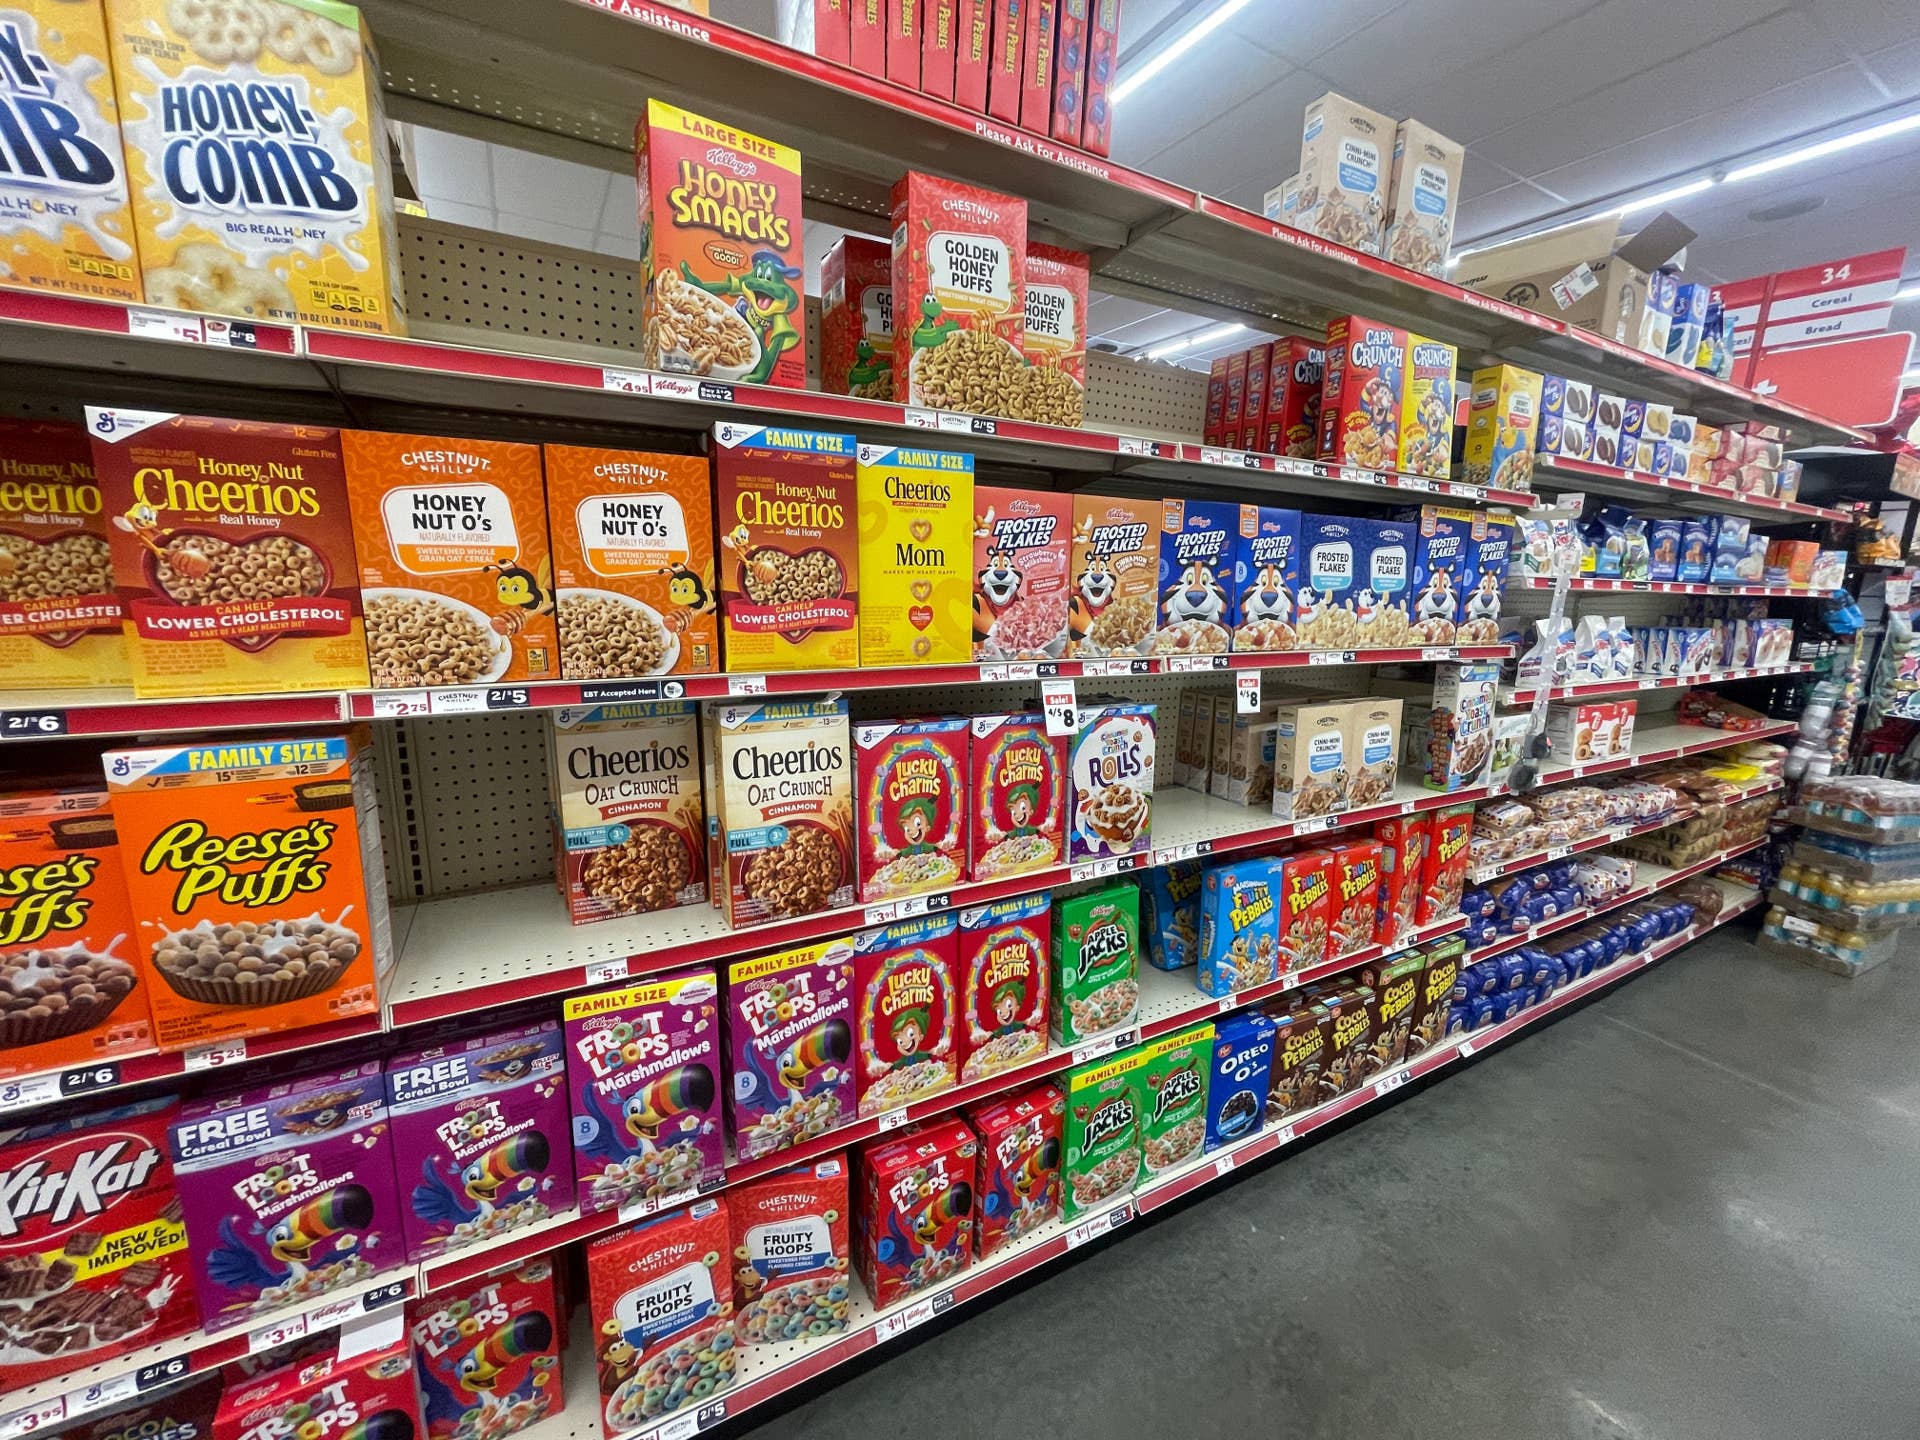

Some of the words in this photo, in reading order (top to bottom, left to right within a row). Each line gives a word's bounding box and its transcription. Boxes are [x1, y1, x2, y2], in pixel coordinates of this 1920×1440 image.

[682, 116, 737, 146] LARGE
[742, 132, 776, 159] SIZE
[975, 122, 1012, 146] Please
[1015, 136, 1035, 154] Ask
[1037, 143, 1055, 160] For
[1057, 151, 1109, 179] Assistance
[669, 187, 791, 249] SMACKS
[942, 199, 1000, 224] CHESTNUT
[226, 222, 247, 234] BIG
[250, 224, 283, 237] REAL
[944, 239, 999, 262] GOLDEN
[1272, 227, 1296, 246] Please
[1297, 236, 1310, 250] Ask
[1311, 238, 1323, 253] For
[1323, 244, 1359, 265] Assistance
[712, 251, 740, 266] GOOD!
[949, 256, 995, 279] HONEY
[951, 274, 993, 294] PUFFS
[1821, 264, 1851, 285] 34
[1811, 293, 1853, 308] Cereal
[1025, 320, 1060, 335] PUFFS
[1805, 321, 1842, 335] Bread
[766, 430, 813, 450] FAMILY
[816, 434, 843, 452] SIZE
[198, 458, 261, 482] Honey
[268, 462, 304, 480] Nut
[401, 450, 491, 471] CHESTNUT
[430, 463, 466, 475] HILL
[897, 451, 938, 468] FAMILY
[941, 454, 964, 469] SIZE
[594, 463, 669, 482] CHESTNUT
[132, 467, 320, 517] Cheerios
[776, 482, 813, 502] Honey
[816, 485, 837, 501] Nut
[884, 475, 951, 502] Cheerios
[413, 493, 487, 514] HONEY
[603, 502, 663, 520] HONEY
[736, 491, 844, 530] Cheerios
[412, 514, 456, 531] NUT
[461, 513, 493, 533] O's
[601, 521, 639, 537] NUT
[642, 521, 668, 537] O's
[993, 516, 1057, 536] FROSTED
[1091, 524, 1148, 542] FROSTED
[419, 532, 456, 543] NATURALLY
[457, 532, 491, 543] FLAVORED
[785, 527, 800, 538] Real
[801, 528, 822, 540] Honey
[998, 531, 1051, 550] FLAKES
[1175, 530, 1226, 547] FROSTED
[1251, 535, 1292, 550] FROSTED
[1428, 536, 1461, 551] FROSTED
[416, 547, 463, 556] SWEETENED
[466, 547, 496, 556] WHOLE
[896, 543, 945, 567] Mom
[1095, 537, 1142, 555] FLAKES
[1177, 542, 1221, 558] FLAKES
[1253, 547, 1288, 561] FLAKES
[1429, 547, 1457, 560] FLAKES
[1479, 541, 1508, 554] FROSTED
[418, 554, 444, 563] GRAIN
[445, 554, 462, 563] OAT
[464, 554, 495, 563] CEREAL
[1317, 552, 1350, 563] FROSTED
[1376, 555, 1404, 566] FROSTED
[1480, 551, 1505, 563] FLAKES
[1319, 562, 1346, 573] FLAKES
[1378, 565, 1401, 576] FLAKES
[216, 603, 241, 615] CAN
[245, 601, 275, 614] HELP
[735, 612, 776, 625] LOWER
[777, 607, 849, 623] CHOLESTEROL
[775, 604, 792, 614] CAN
[793, 602, 814, 612] HELP
[147, 616, 216, 630] LOWER
[220, 609, 344, 628] CHOLESTEROL
[438, 692, 479, 702] CHESTNUT
[490, 689, 527, 704] 2/$5
[584, 689, 598, 698] EBT
[600, 688, 634, 697] Accepted
[636, 687, 656, 696] Here
[1049, 695, 1069, 705] Sale!
[602, 703, 651, 719] FAMILY
[655, 701, 686, 716] SIZE
[765, 705, 809, 720] FAMILY
[813, 702, 839, 716] SIZE
[8, 714, 60, 732] 2/$6
[188, 744, 274, 771] FAMILY
[280, 741, 328, 763] SIZE
[568, 745, 690, 780] Cheerios
[733, 745, 843, 781] Cheerios
[1089, 744, 1142, 788] ROLLS
[585, 782, 616, 806] OAT
[619, 775, 680, 797] CRUNCH
[748, 784, 776, 807] OAT
[779, 776, 833, 798] CRUNCH
[608, 801, 662, 816] CINNAMON
[768, 802, 818, 817] CINNAMON
[142, 818, 338, 875] Reese's
[567, 837, 590, 846] FULL
[730, 838, 751, 848] FULL
[174, 854, 330, 914] Puffs
[1339, 868, 1378, 901] PEBBLES
[990, 902, 1022, 917] FAMILY
[1024, 896, 1044, 911] SIZE
[1288, 880, 1329, 916] PEBBLES
[1229, 896, 1274, 933] PEBBLES
[736, 958, 784, 977] FAMILY
[786, 950, 817, 966] SIZE
[571, 993, 630, 1014] FAMILY
[634, 987, 668, 1003] SIZE
[1379, 988, 1417, 1025] PEBBLES
[756, 996, 850, 1053] Marshmallows
[1331, 1016, 1371, 1051] PEBBLES
[1157, 1037, 1186, 1054] FAMILY
[1187, 1031, 1206, 1045] SIZE
[1220, 1043, 1269, 1076] OREO
[1280, 1036, 1325, 1071] PEBBLES
[67, 1068, 114, 1087] 2/$6
[393, 1057, 469, 1092] FREE
[596, 1039, 712, 1097] Marshmallows
[1085, 1065, 1118, 1085] FAMILY
[1119, 1058, 1139, 1073] SIZE
[395, 1083, 437, 1103] Cereal
[439, 1076, 470, 1092] Bowl
[1164, 1070, 1193, 1090] APPLE
[177, 1107, 270, 1149] FREE
[182, 1135, 231, 1158] Cereal
[234, 1127, 272, 1148] Bowl
[758, 1193, 818, 1212] CHESTNUT
[106, 1231, 148, 1252] NEW
[152, 1225, 168, 1239] &
[763, 1231, 813, 1246] FRUITY
[87, 1230, 187, 1271] IMPROVED!
[764, 1242, 813, 1257] HOOPS
[368, 1284, 402, 1302] 2/$6
[635, 1281, 693, 1313] FRUITY
[311, 1300, 357, 1321] Kellogg's
[637, 1294, 694, 1324] HOOPS
[142, 1360, 185, 1381] 2/$6
[700, 1401, 726, 1422] 2/$5
